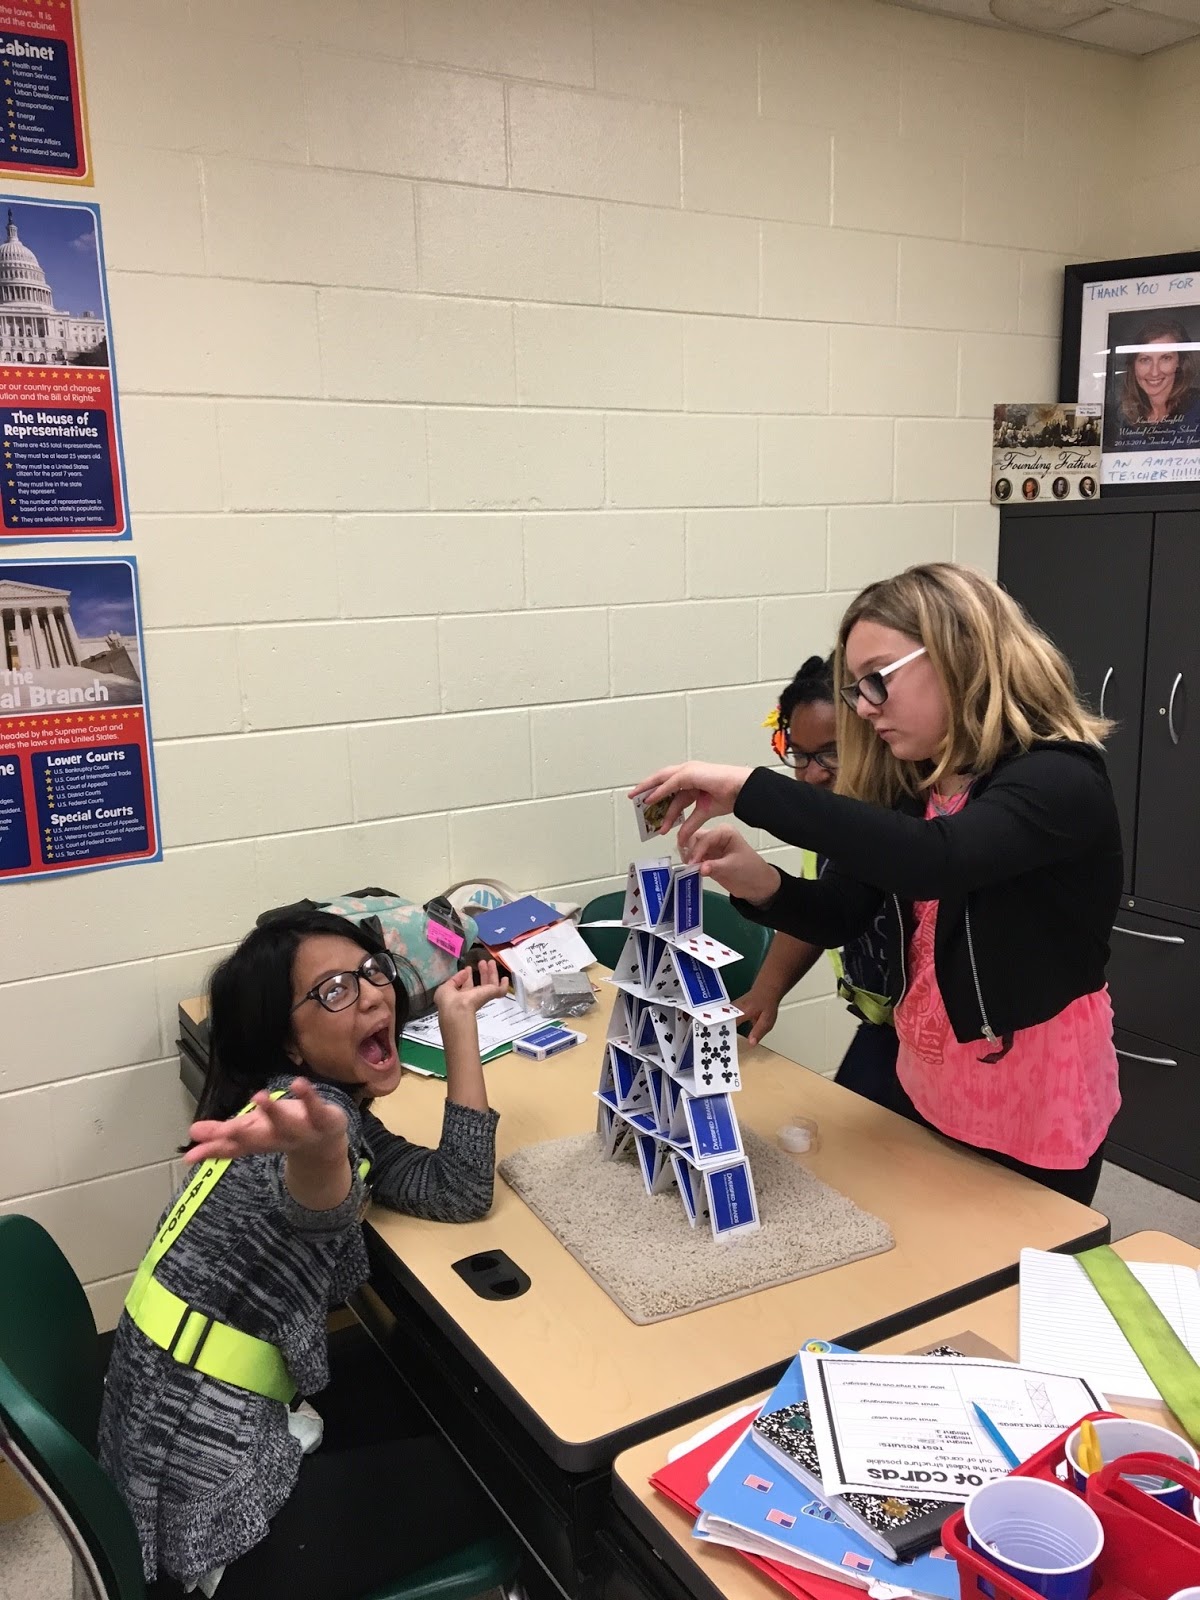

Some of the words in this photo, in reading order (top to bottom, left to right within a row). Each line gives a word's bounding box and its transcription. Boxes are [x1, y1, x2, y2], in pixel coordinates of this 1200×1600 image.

[14, 8, 35, 18] laws.
[12, 17, 25, 27] the
[27, 20, 57, 32] cabinet.
[12, 62, 30, 71] Health
[32, 64, 42, 72] and
[12, 69, 33, 78] Human
[34, 72, 57, 81] Services
[13, 81, 37, 91] Housing
[38, 84, 49, 92] and
[14, 88, 32, 97] Urban
[33, 91, 69, 102] Development
[15, 100, 54, 111] Transportation
[16, 111, 35, 121] Energy
[17, 123, 45, 133] Education
[19, 135, 43, 144] Veterans
[44, 137, 61, 146] Affairs
[20, 147, 49, 156] Homeland
[50, 149, 70, 159] Security
[1087, 284, 1128, 300] THANK
[1136, 282, 1158, 296] YOU
[1169, 278, 1193, 291] FOR
[23, 384, 51, 394] country
[53, 384, 67, 392] and
[69, 384, 101, 394] changes
[20, 393, 35, 401] and
[37, 393, 49, 401] the
[72, 394, 96, 403] Rights.
[11, 411, 34, 424] The
[37, 412, 73, 425] House
[77, 412, 89, 425] of
[4, 424, 98, 439] Representatives
[1147, 426, 1176, 435] Elementary
[1177, 425, 1198, 433] School
[1148, 437, 1169, 445] Teacher
[1170, 437, 1177, 446] of
[1000, 450, 1050, 478] Founding
[1055, 450, 1097, 469] Fathers
[1113, 459, 1132, 468] AN
[1141, 457, 1200, 467] AMAZIN
[2, 668, 33, 685] The
[29, 679, 109, 707] Branch
[1, 730, 29, 741] headed
[31, 730, 40, 741] by
[42, 729, 53, 738] the
[54, 727, 87, 738] Supreme
[88, 724, 107, 733] Court
[109, 723, 123, 731] and
[17, 740, 28, 748] the
[30, 738, 48, 747] laws
[58, 736, 69, 744] the
[71, 734, 95, 743] United
[96, 733, 119, 741] States.
[47, 755, 82, 767] Lower
[86, 750, 125, 763] Courts
[65, 765, 92, 775] Bankruptcy
[86, 771, 117, 780] International
[87, 781, 108, 790] Appeals
[51, 810, 92, 827] Special
[95, 806, 133, 819] Courts
[119, 818, 139, 826] Appeals
[65, 832, 87, 840] Veterans
[88, 830, 105, 838] Claims
[125, 826, 145, 834] Appeals
[708, 1121, 719, 1150] DIVERSIFIED
[726, 1172, 736, 1202] DIVERSIFIED
[731, 1202, 739, 1224] BRANDS
[160, 1168, 213, 1243] PATROL
[904, 1460, 944, 1468] structure
[867, 1468, 948, 1482] cards
[954, 1473, 983, 1487] of
